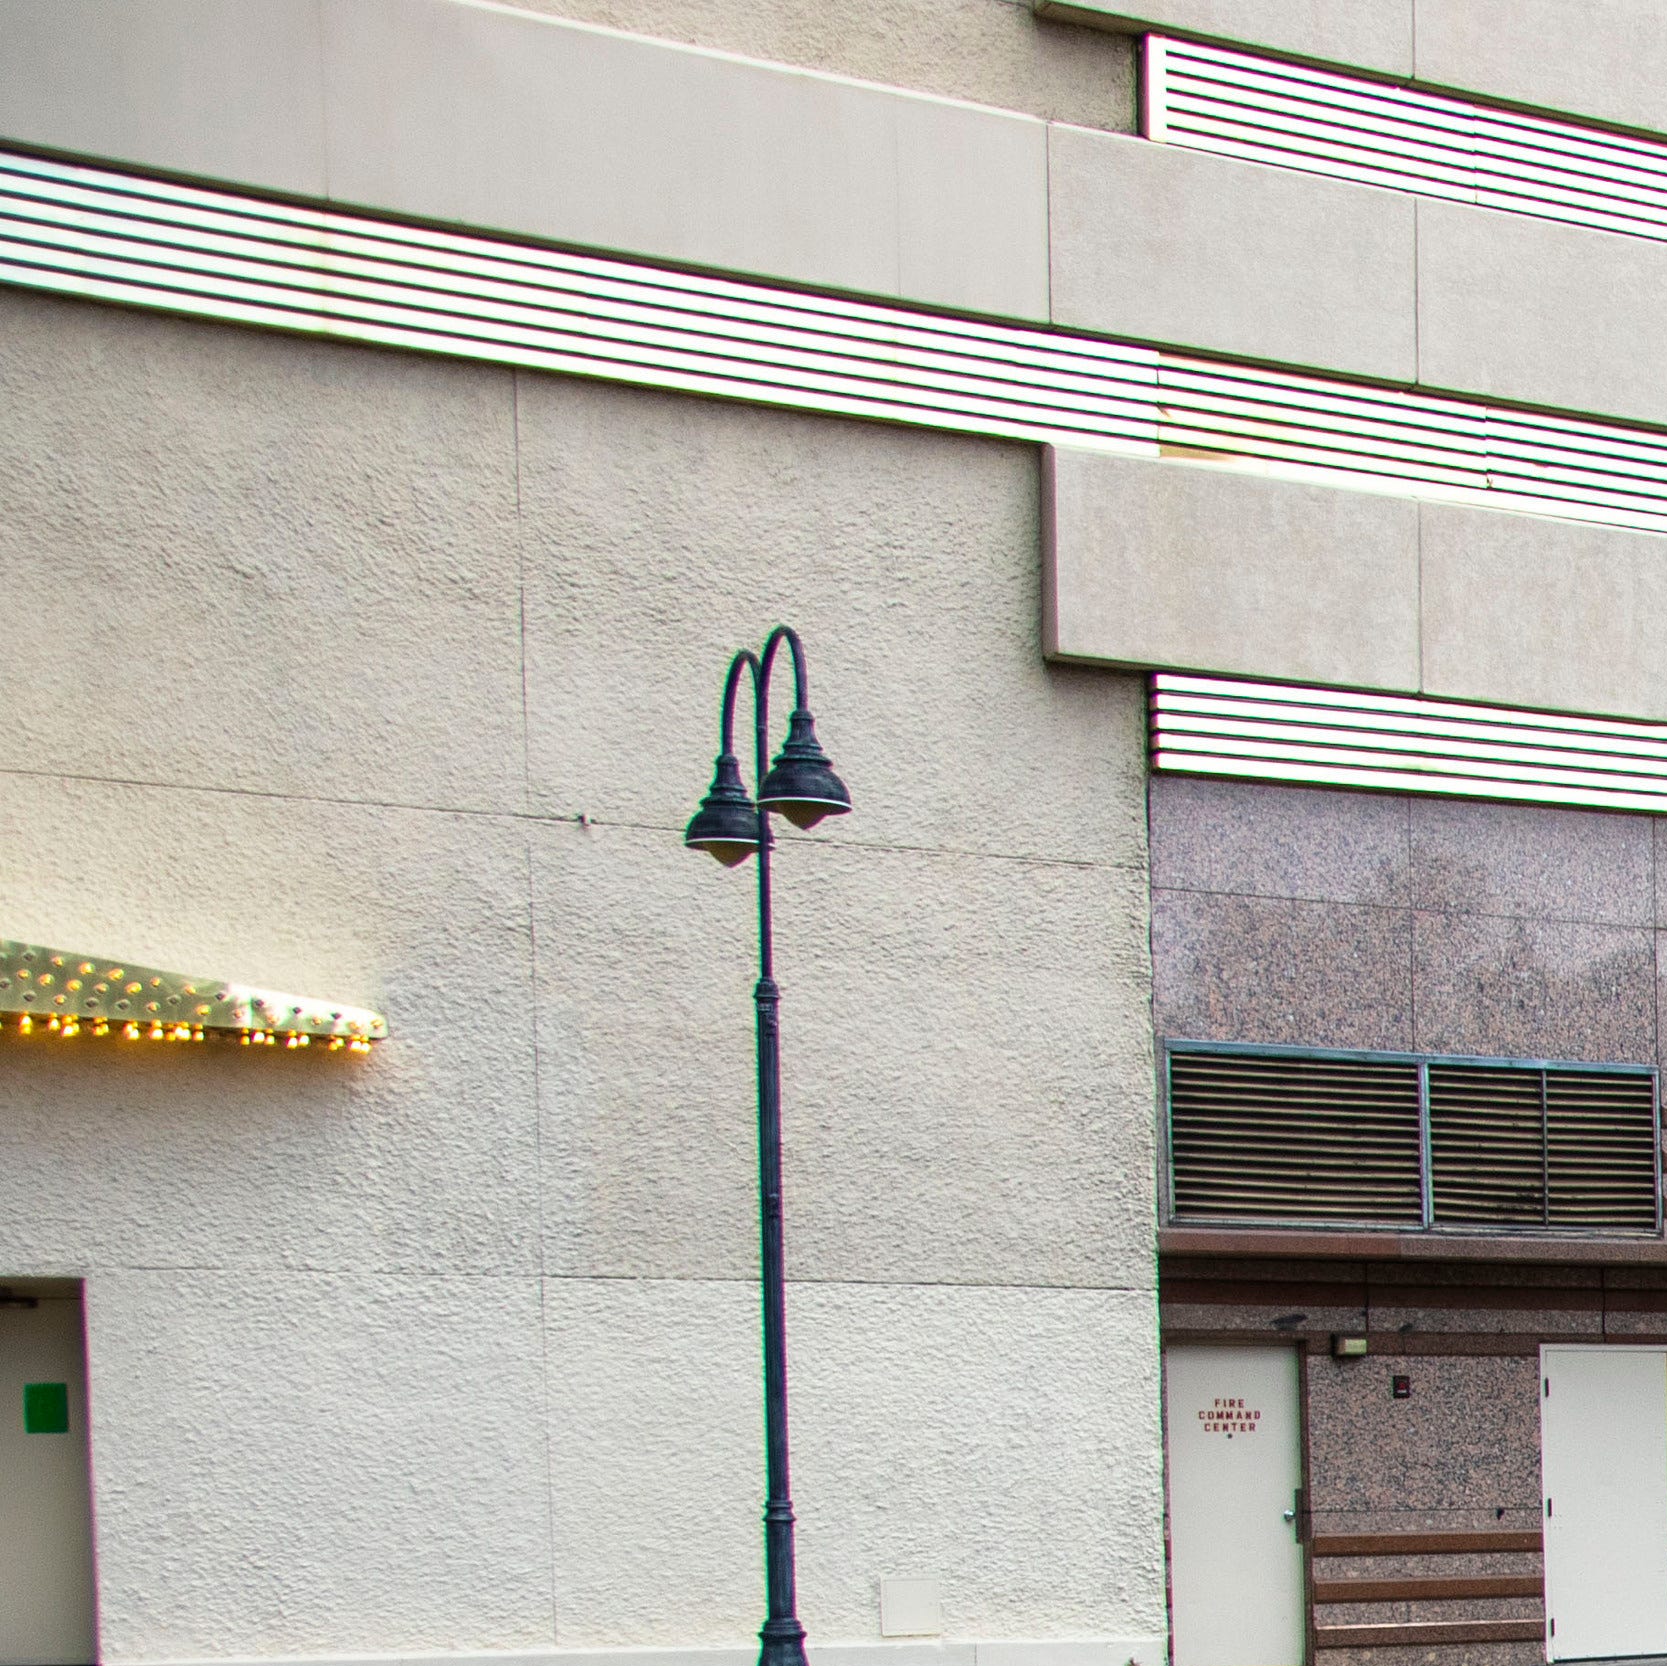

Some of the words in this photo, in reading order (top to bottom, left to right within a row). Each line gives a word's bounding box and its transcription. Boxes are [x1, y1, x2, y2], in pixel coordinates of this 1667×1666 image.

[1214, 1398, 1245, 1408] FIRE
[1198, 1410, 1261, 1420] COMMAND
[1204, 1422, 1256, 1432] CENTER
